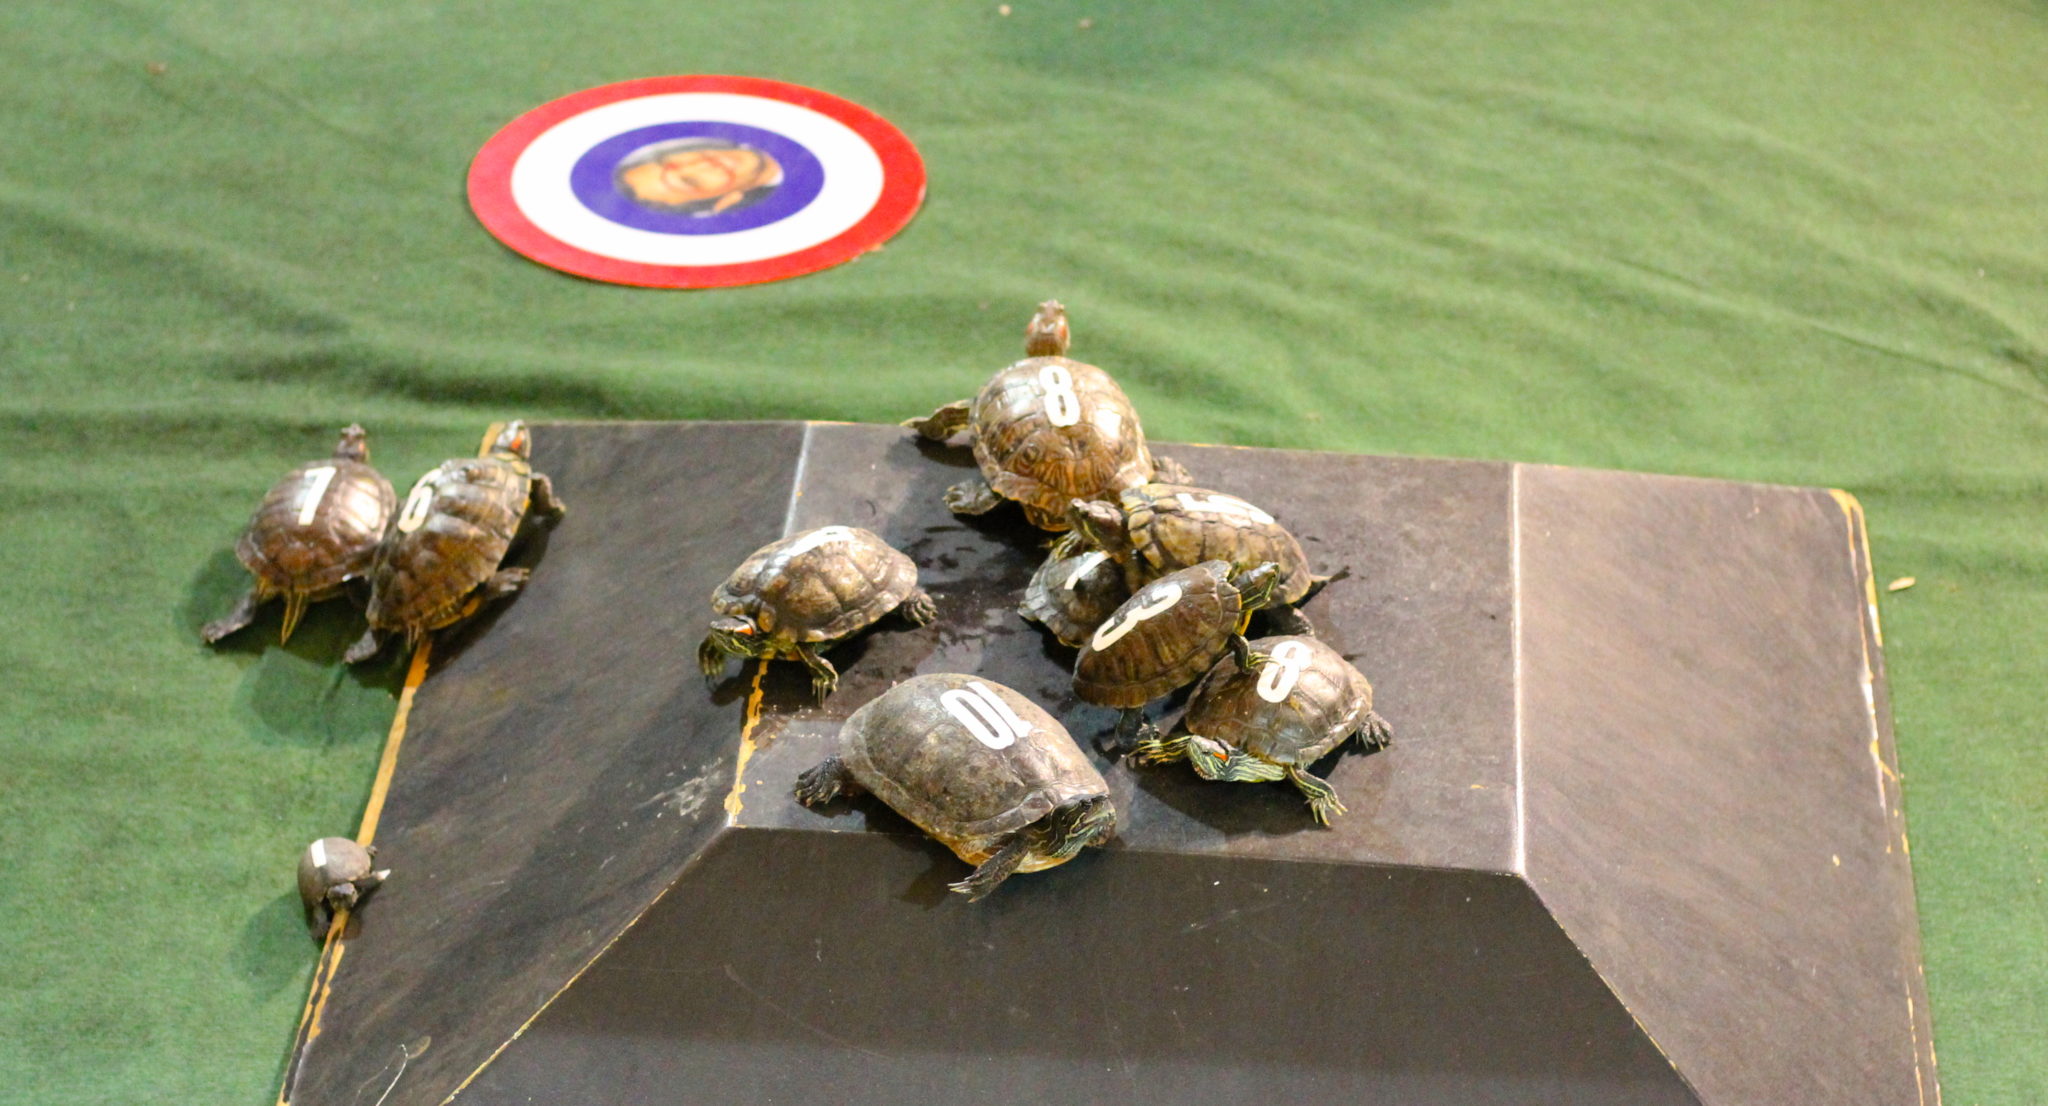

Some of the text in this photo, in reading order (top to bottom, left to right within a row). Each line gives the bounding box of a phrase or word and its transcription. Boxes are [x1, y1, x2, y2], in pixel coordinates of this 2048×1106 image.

[1039, 365, 1081, 427] 8
[298, 466, 337, 526] 7
[398, 468, 442, 533] 6
[1091, 583, 1183, 652] 3
[940, 681, 1033, 750] 10
